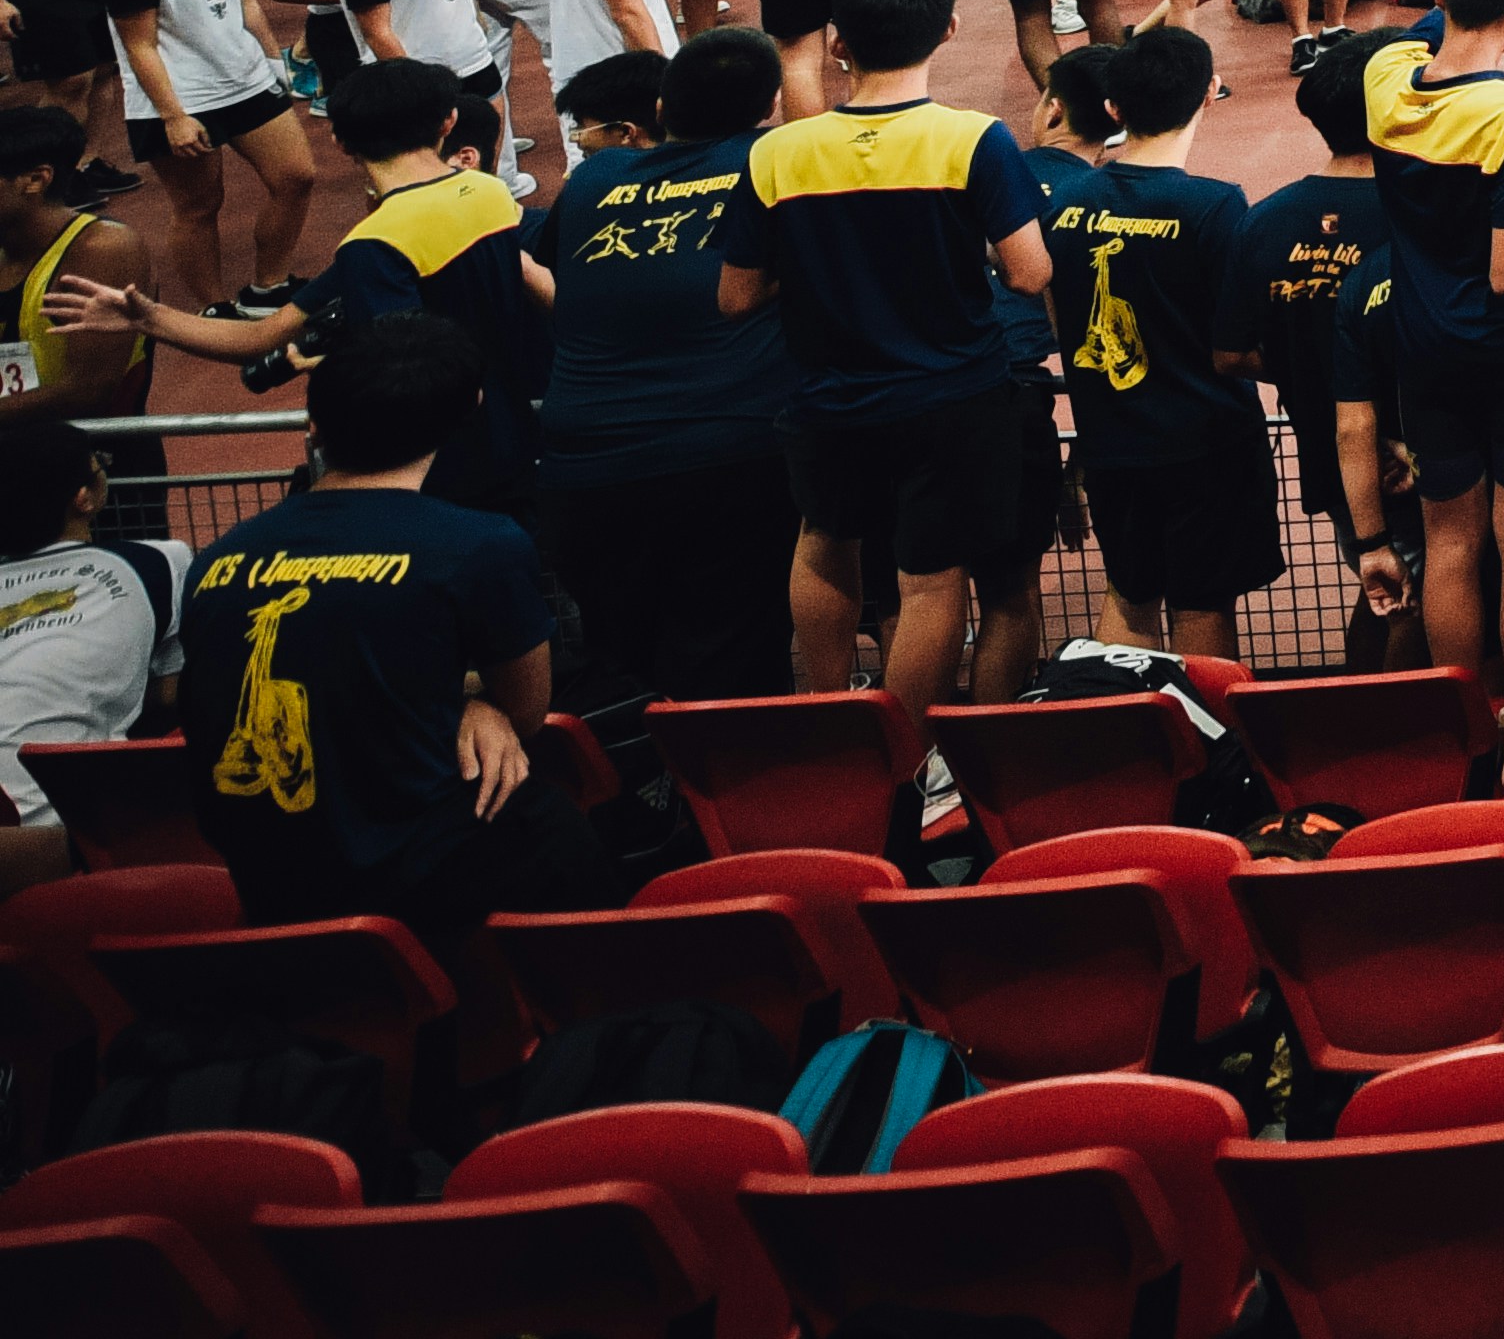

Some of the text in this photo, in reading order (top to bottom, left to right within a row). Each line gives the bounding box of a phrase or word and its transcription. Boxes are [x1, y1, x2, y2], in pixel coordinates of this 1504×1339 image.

[597, 183, 642, 209] ACS
[1052, 207, 1085, 231] ACS
[1364, 279, 1391, 316] ACS
[73, 563, 128, 600] School
[193, 552, 246, 598] ACS
